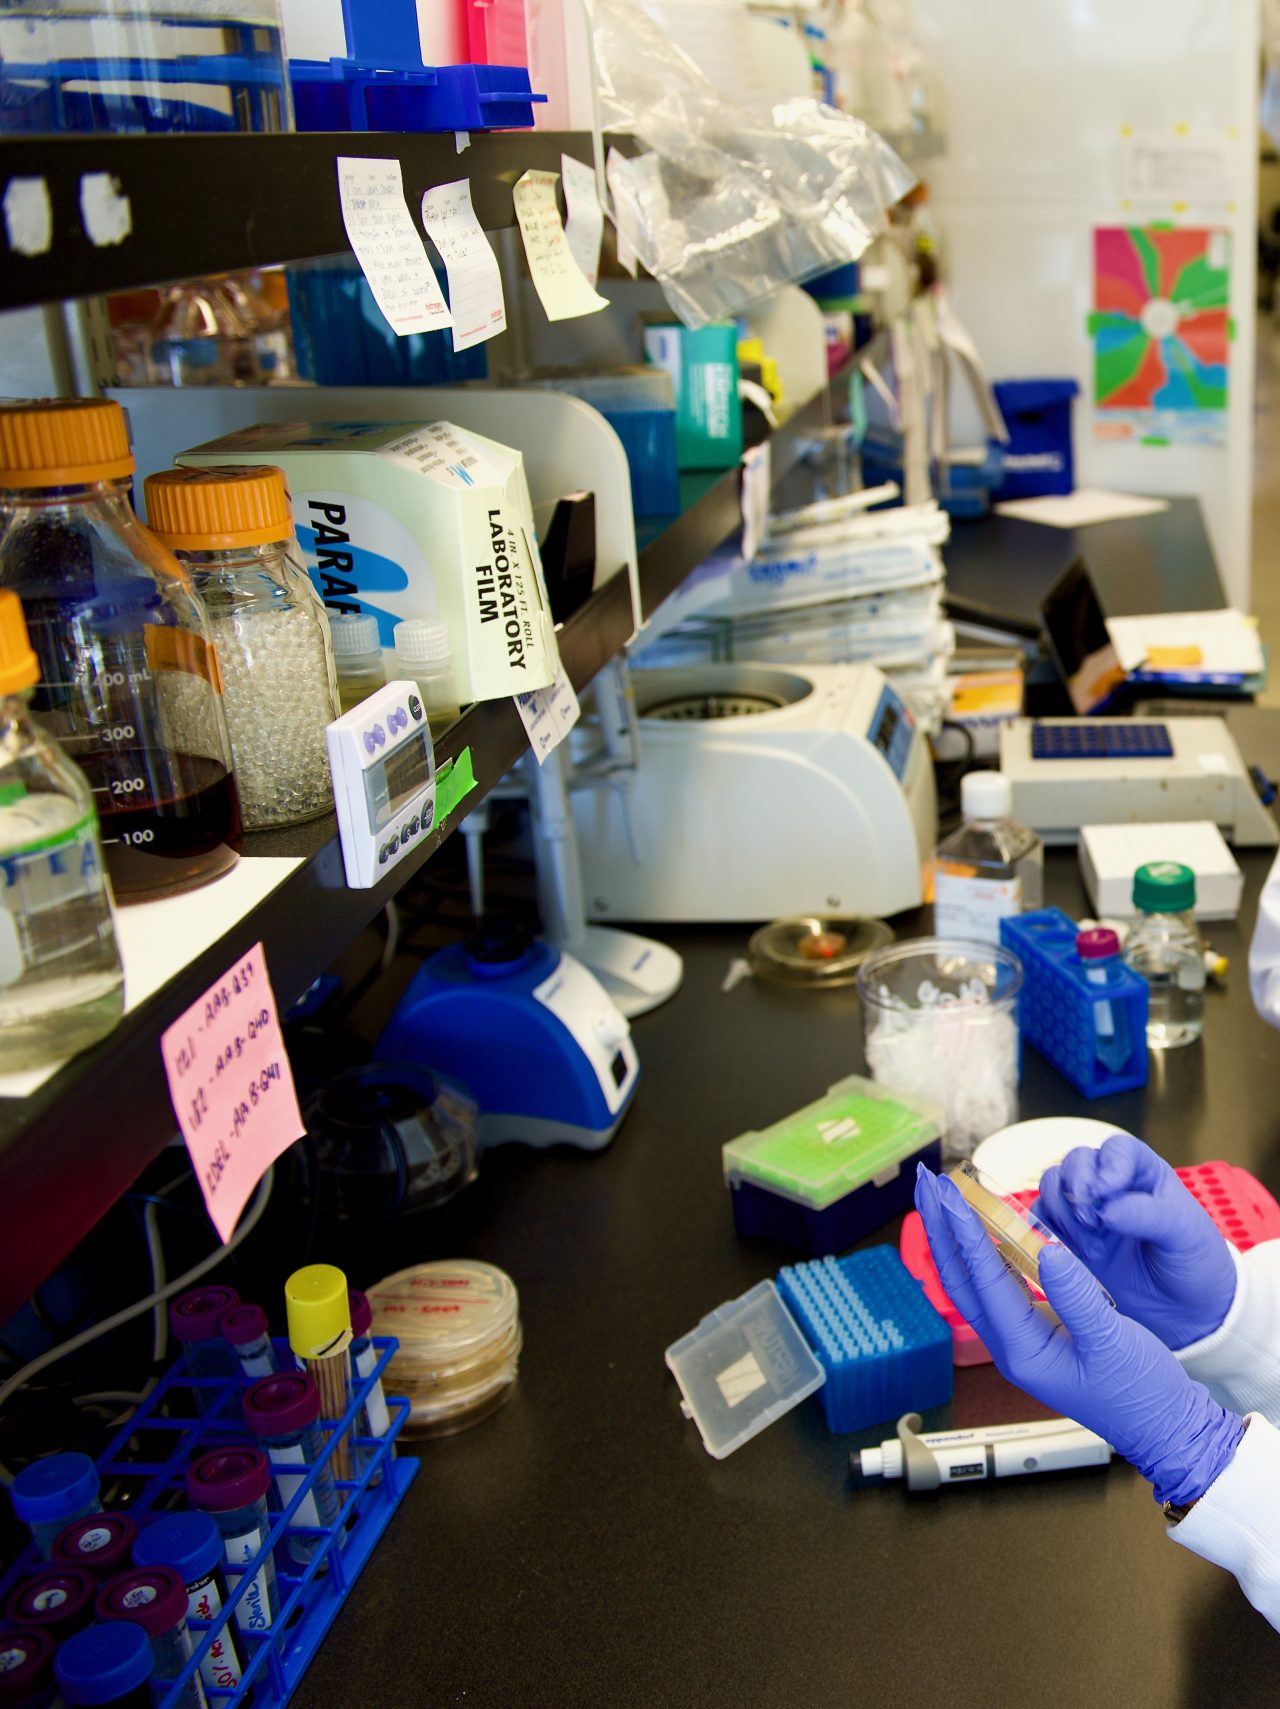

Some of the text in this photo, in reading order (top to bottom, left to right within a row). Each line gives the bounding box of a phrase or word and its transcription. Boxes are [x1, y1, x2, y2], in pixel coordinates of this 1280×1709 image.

[475, 564, 500, 625] FILM
[488, 509, 527, 669] LABORATORY
[507, 529, 514, 537] 4
[515, 575, 525, 597] 125
[522, 620, 535, 649] ROLL
[128, 670, 152, 682] mL
[102, 725, 136, 742] 300
[111, 778, 146, 795] 200
[122, 829, 155, 846] 100
